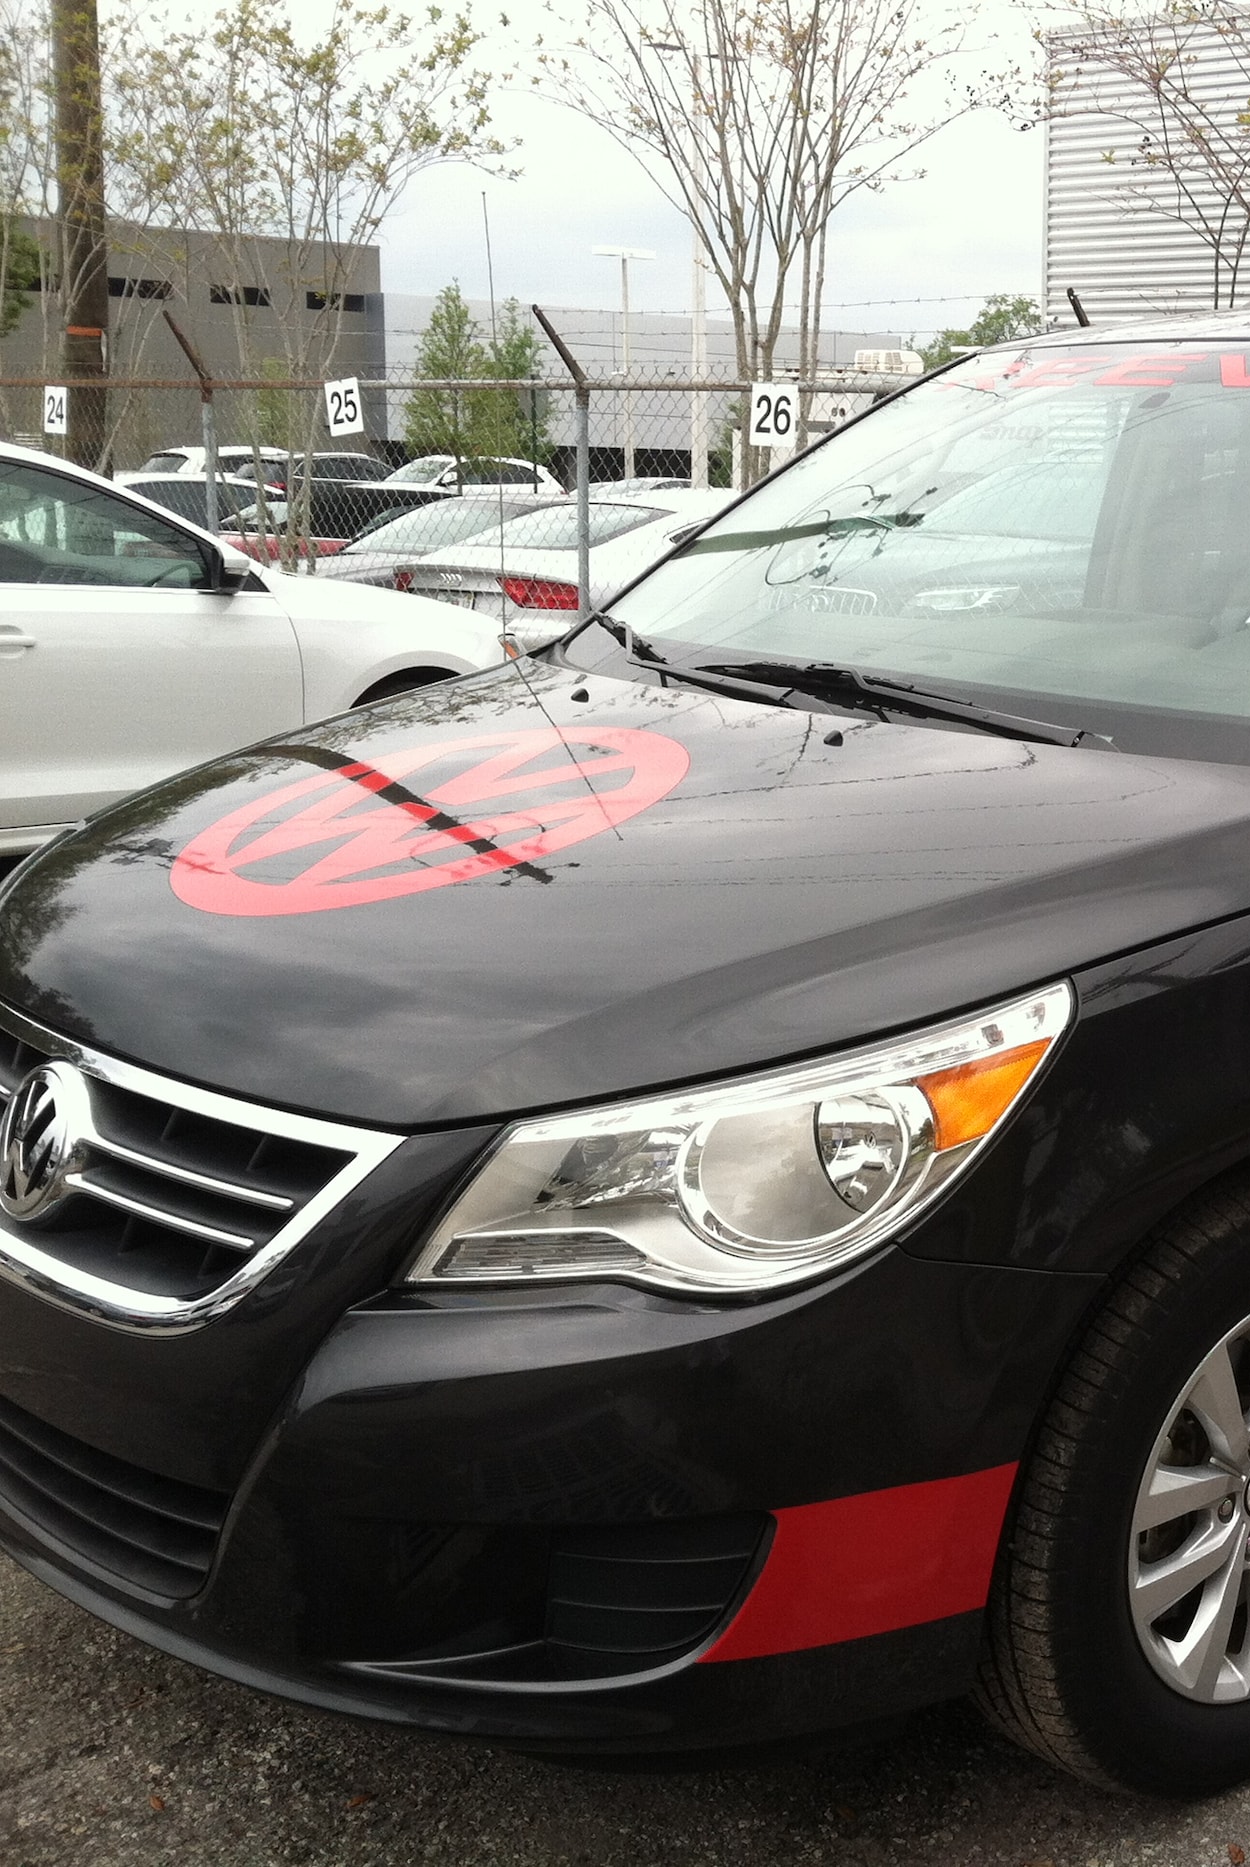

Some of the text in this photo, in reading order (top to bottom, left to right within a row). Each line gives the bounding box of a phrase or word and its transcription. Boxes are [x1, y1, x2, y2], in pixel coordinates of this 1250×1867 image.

[47, 396, 64, 425] 24
[330, 389, 358, 426] 25
[755, 394, 791, 435] 26
